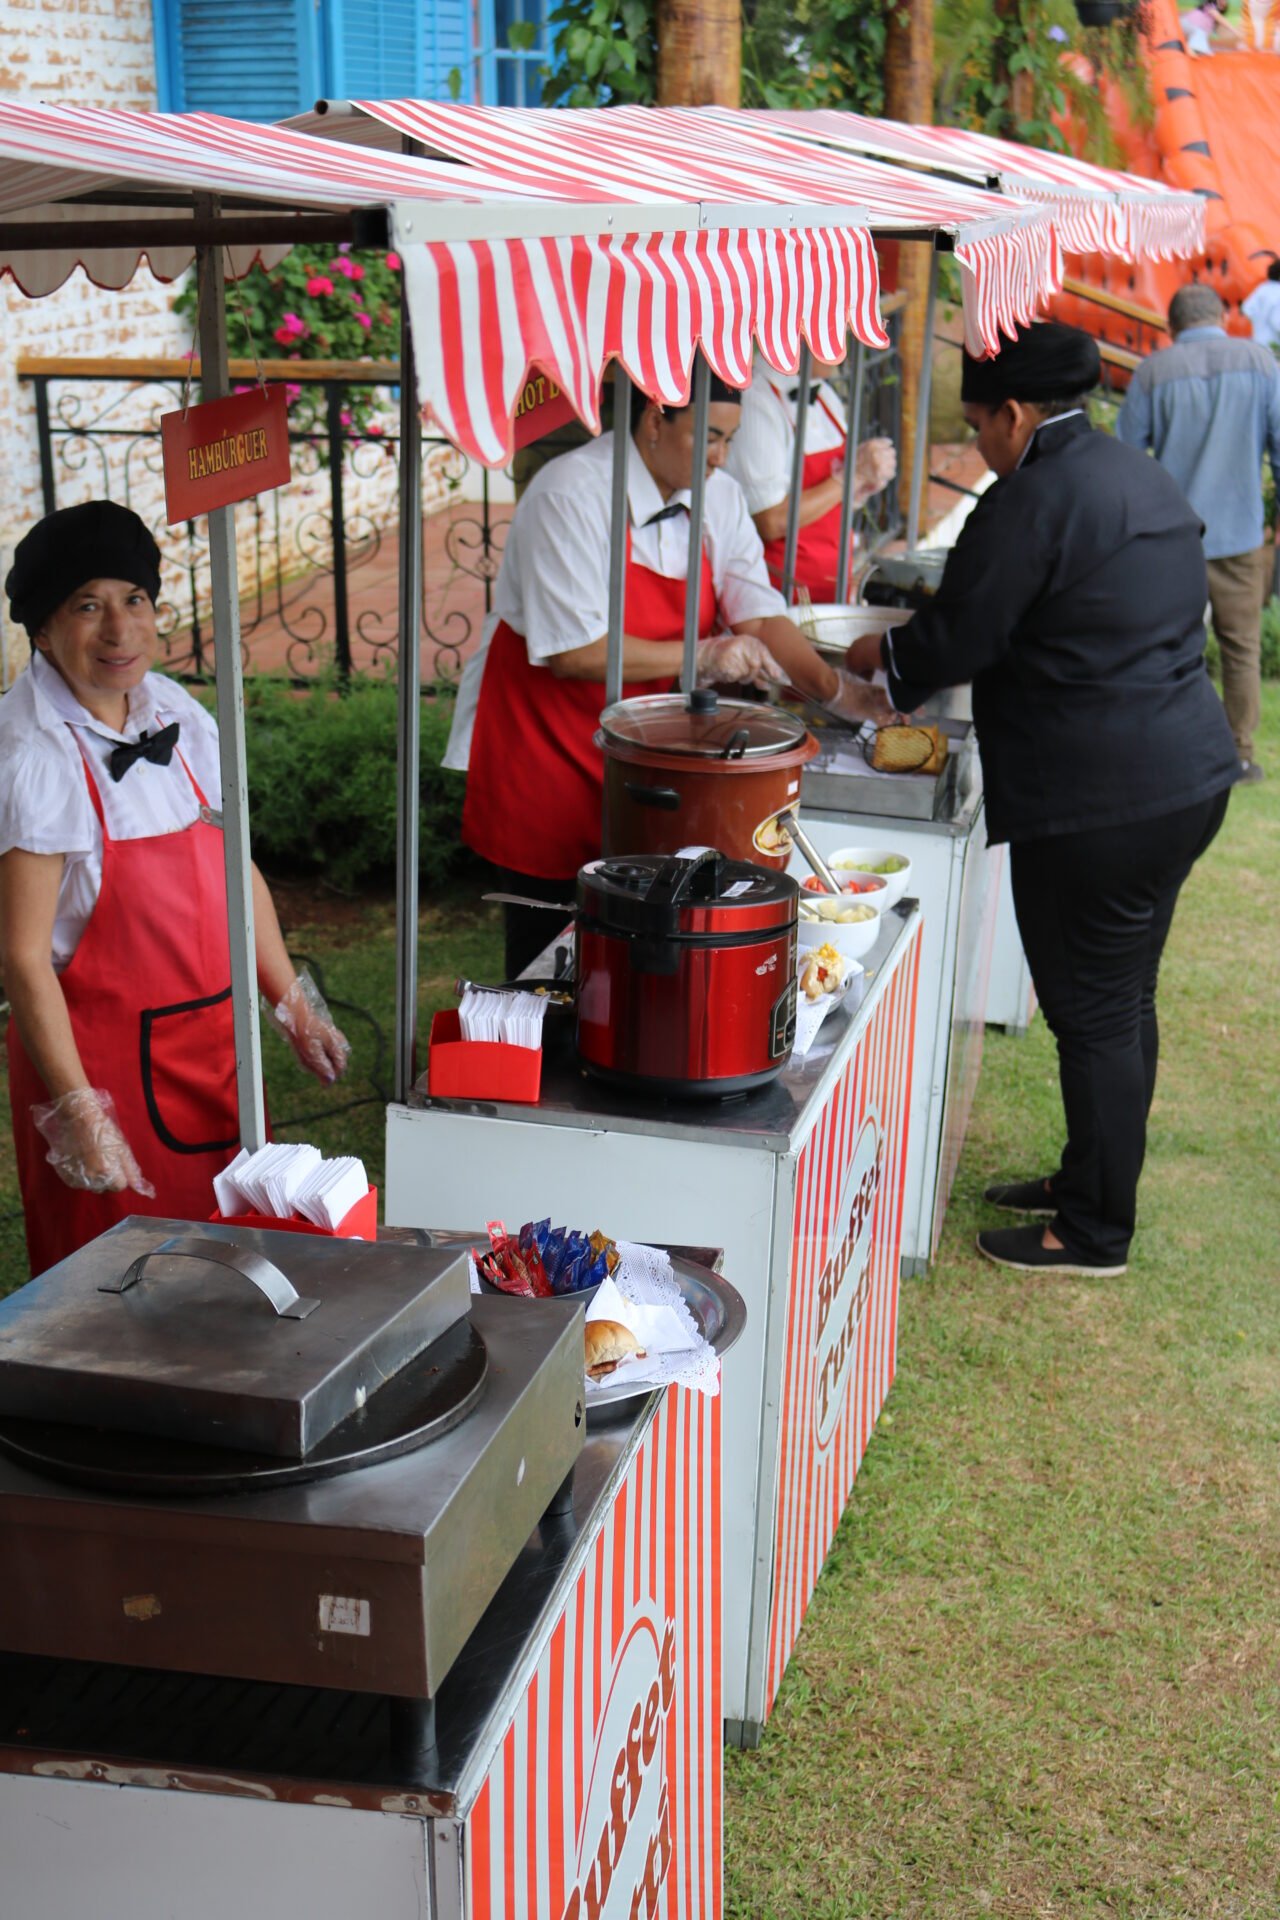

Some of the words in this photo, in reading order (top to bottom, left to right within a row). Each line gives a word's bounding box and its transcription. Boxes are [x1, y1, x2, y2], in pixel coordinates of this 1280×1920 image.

[188, 428, 268, 480] HAMBÚRGUER
[816, 1135, 883, 1348] Buffet
[563, 1621, 676, 1920] uffet
